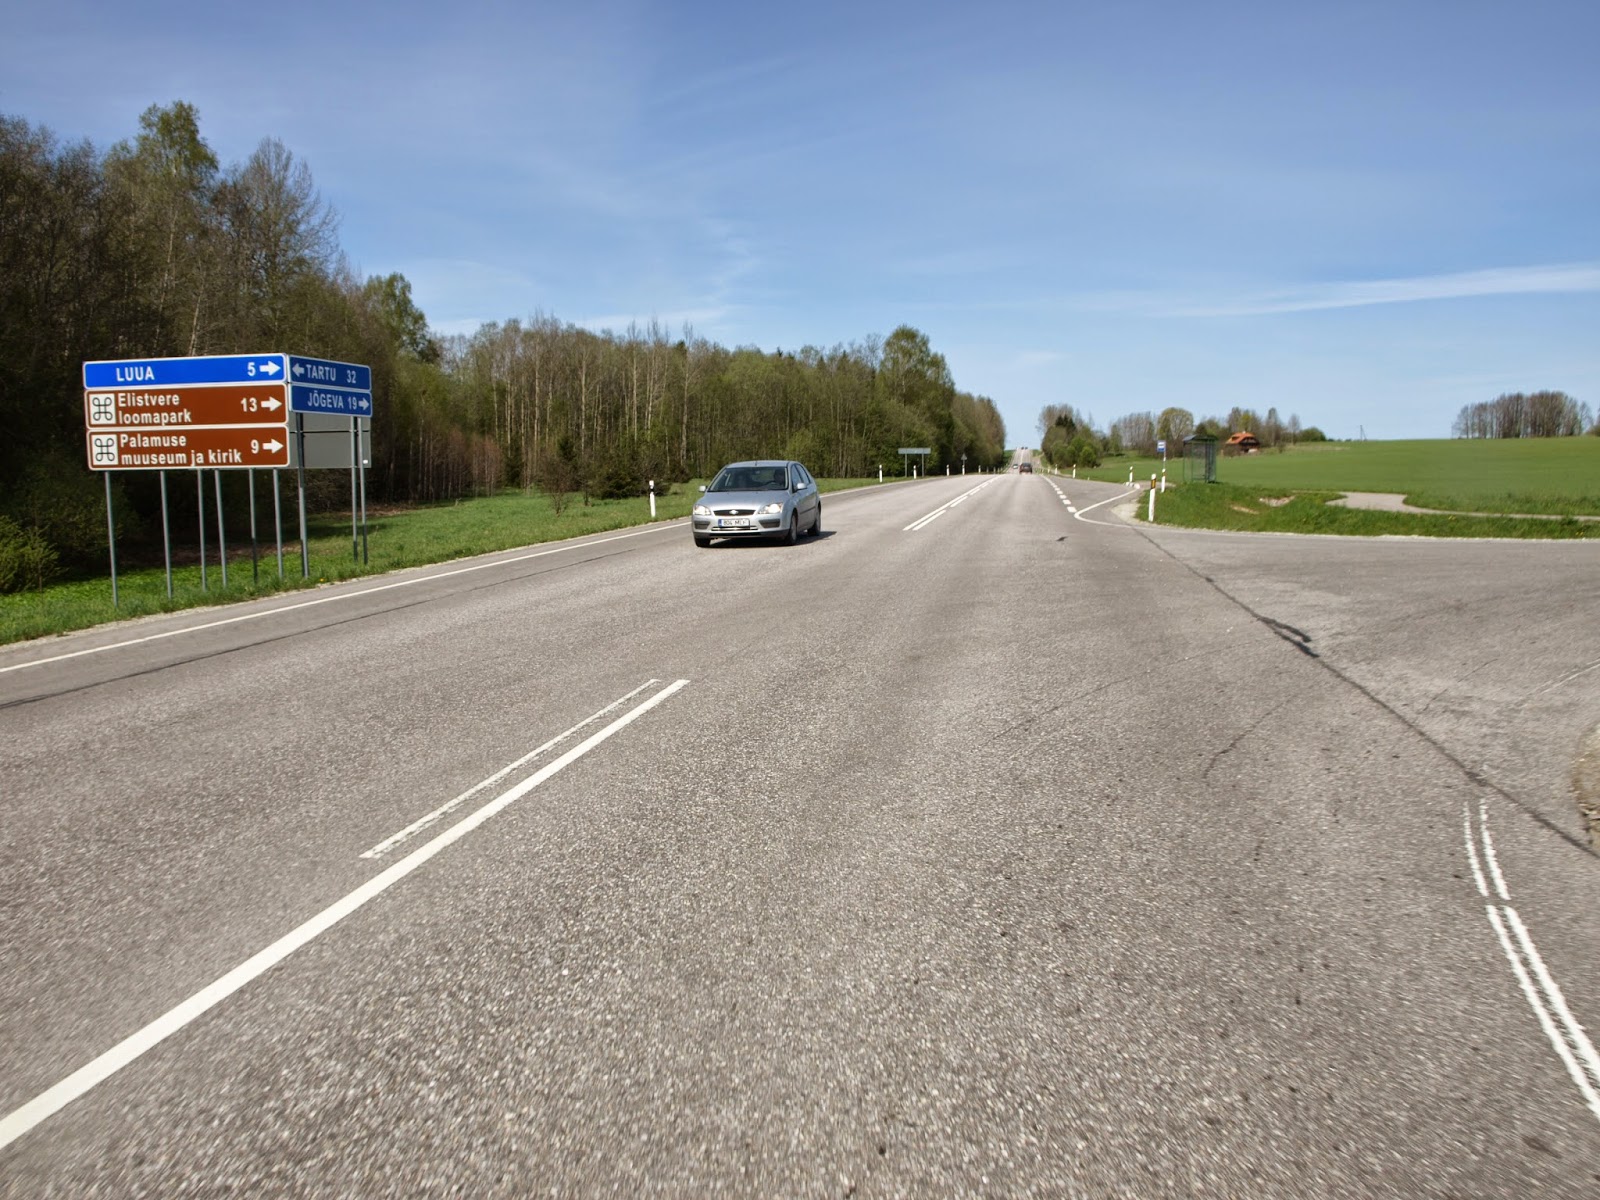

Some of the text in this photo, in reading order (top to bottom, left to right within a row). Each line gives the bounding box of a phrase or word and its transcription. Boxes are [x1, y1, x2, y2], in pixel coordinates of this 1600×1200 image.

[116, 361, 256, 382] LUUA 5
[305, 364, 357, 384] TARTU 32
[117, 392, 180, 407] Elistvere
[240, 397, 258, 412] 13
[307, 390, 358, 410] JÕGEVA 19
[118, 408, 192, 426] loomapark
[119, 433, 187, 448] Palamuse
[250, 439, 260, 454] 9
[121, 448, 242, 467] muuseum ja kirik
